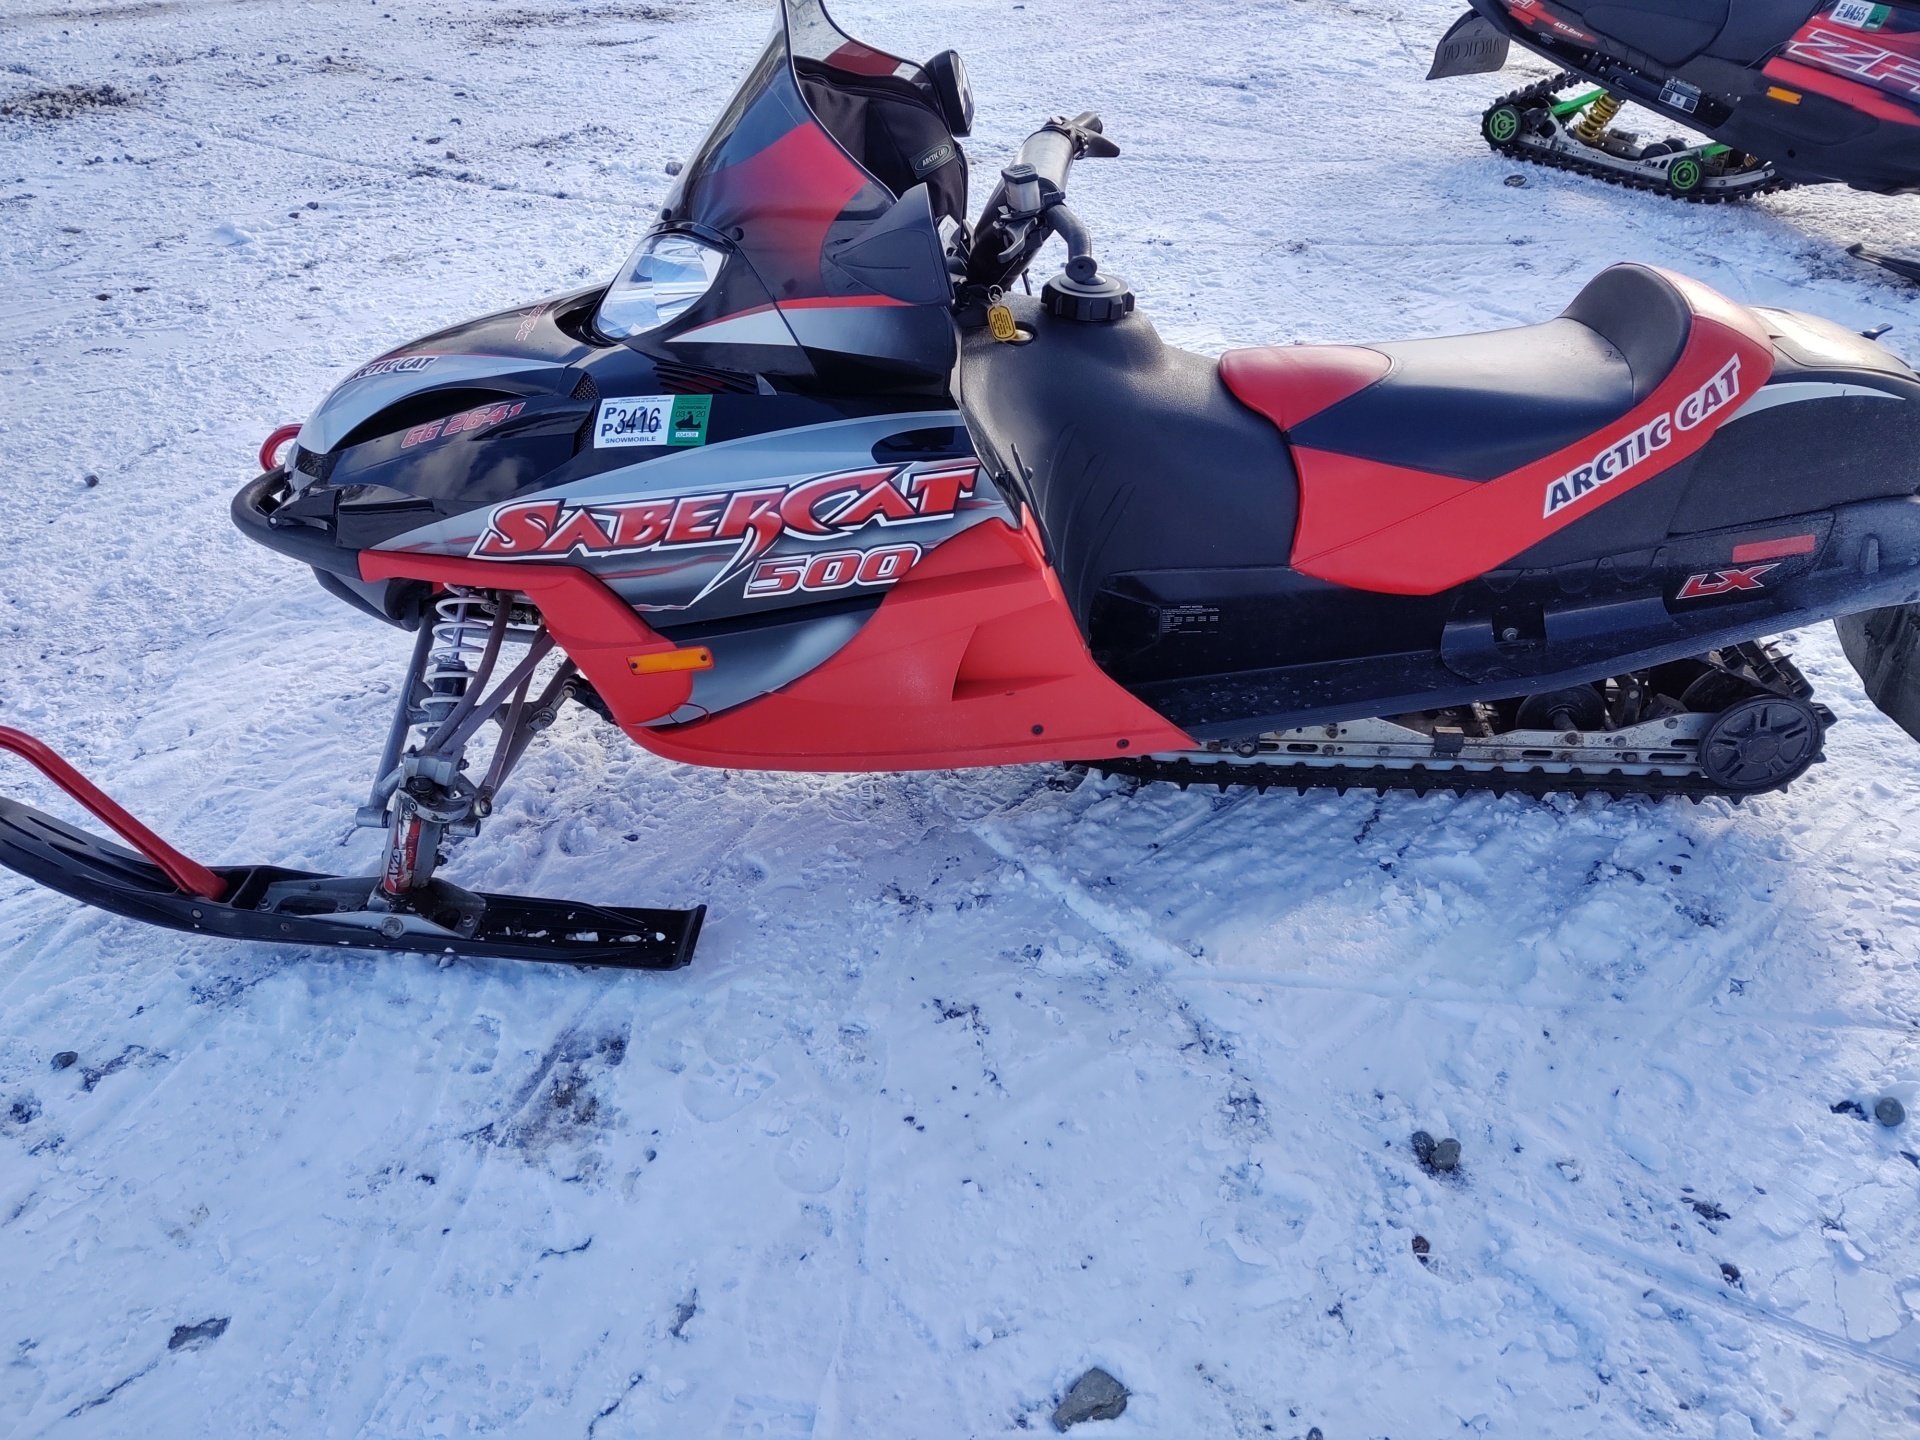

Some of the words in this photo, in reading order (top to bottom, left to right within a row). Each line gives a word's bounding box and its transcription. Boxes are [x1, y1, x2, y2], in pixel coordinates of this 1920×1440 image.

[397, 355, 438, 372] CAT
[441, 402, 526, 437] 2641
[604, 407, 618, 420] P
[614, 407, 661, 434] 3416
[600, 423, 614, 437] P
[604, 435, 657, 444] SNOWMOBILE
[1544, 412, 1671, 518] ARCTIC
[1675, 353, 1741, 431] CAT
[744, 544, 922, 598] 500
[1676, 563, 1781, 599] LX
